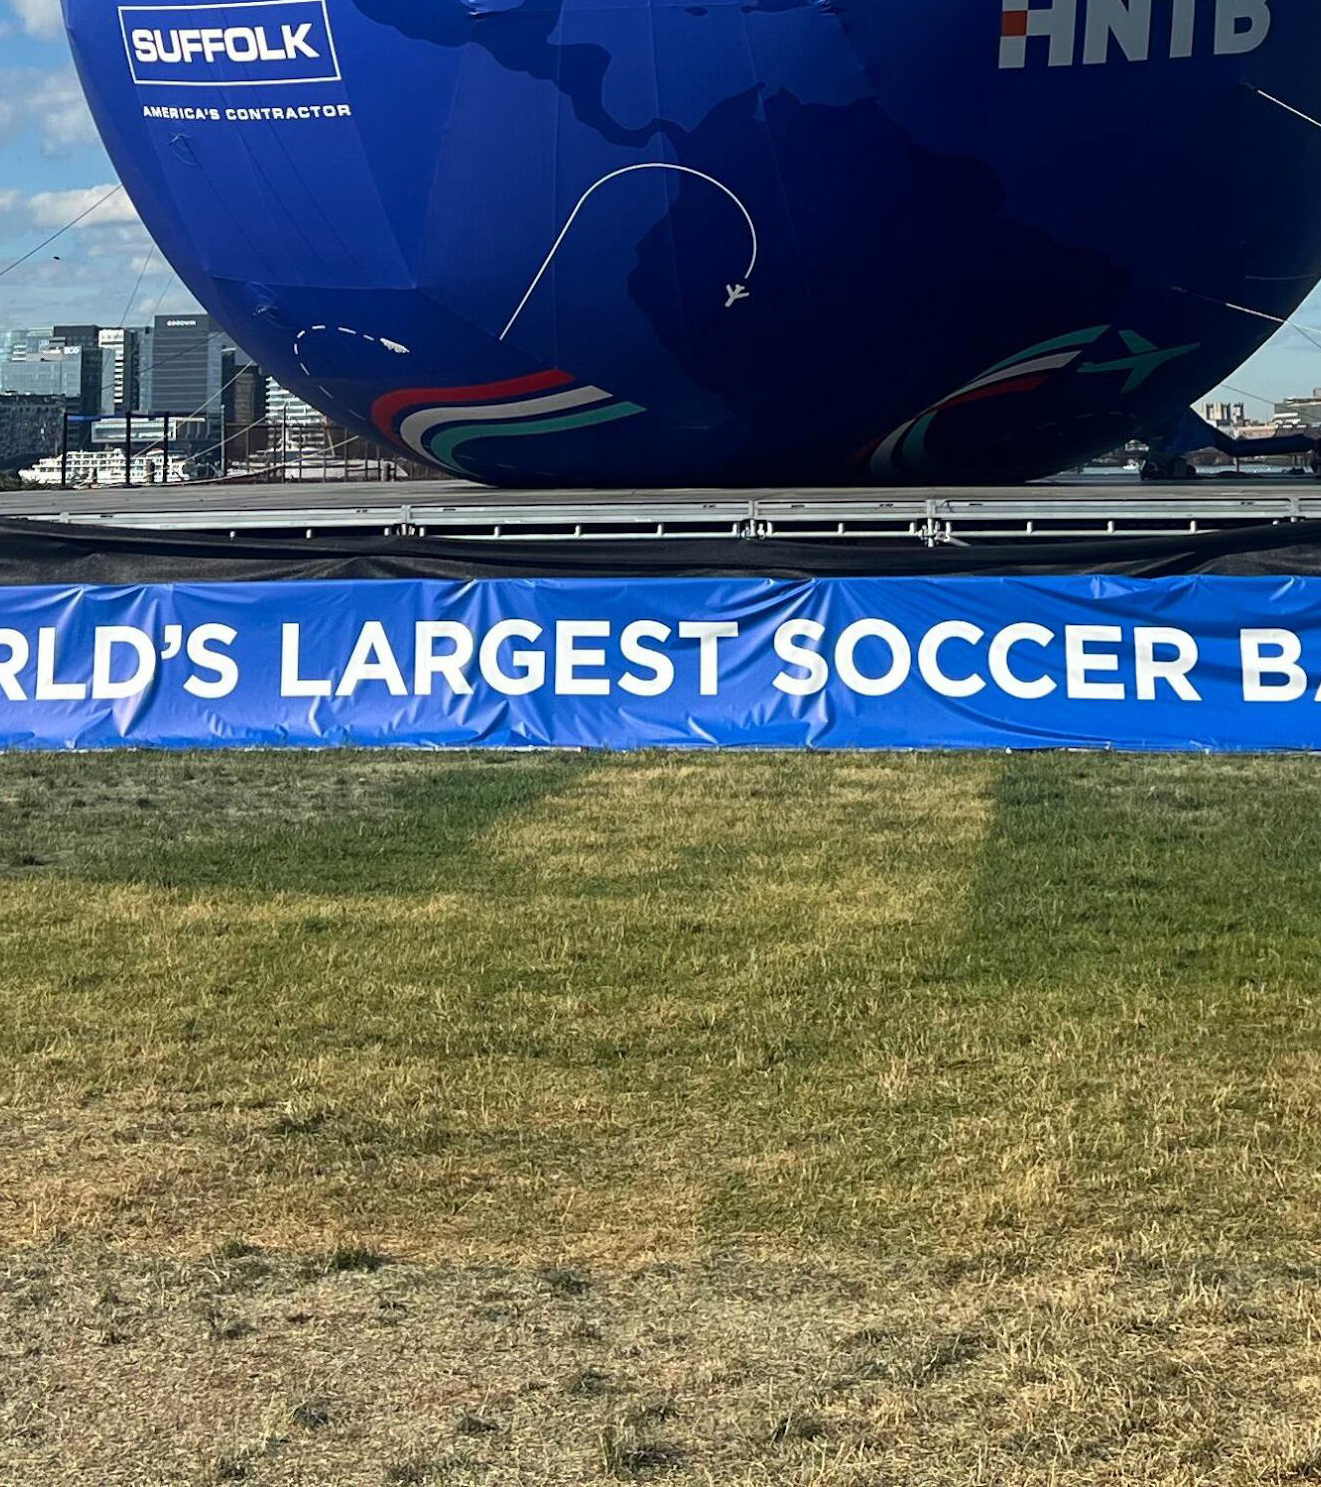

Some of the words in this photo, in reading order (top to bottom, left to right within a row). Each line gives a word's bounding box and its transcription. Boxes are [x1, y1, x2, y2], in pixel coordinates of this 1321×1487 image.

[131, 22, 321, 63] SUFFOLK
[142, 104, 220, 121] AMERICA'S
[225, 103, 353, 121] CONTRACTOR
[278, 617, 739, 699] LARGEST
[771, 618, 1199, 702] SOCCER
